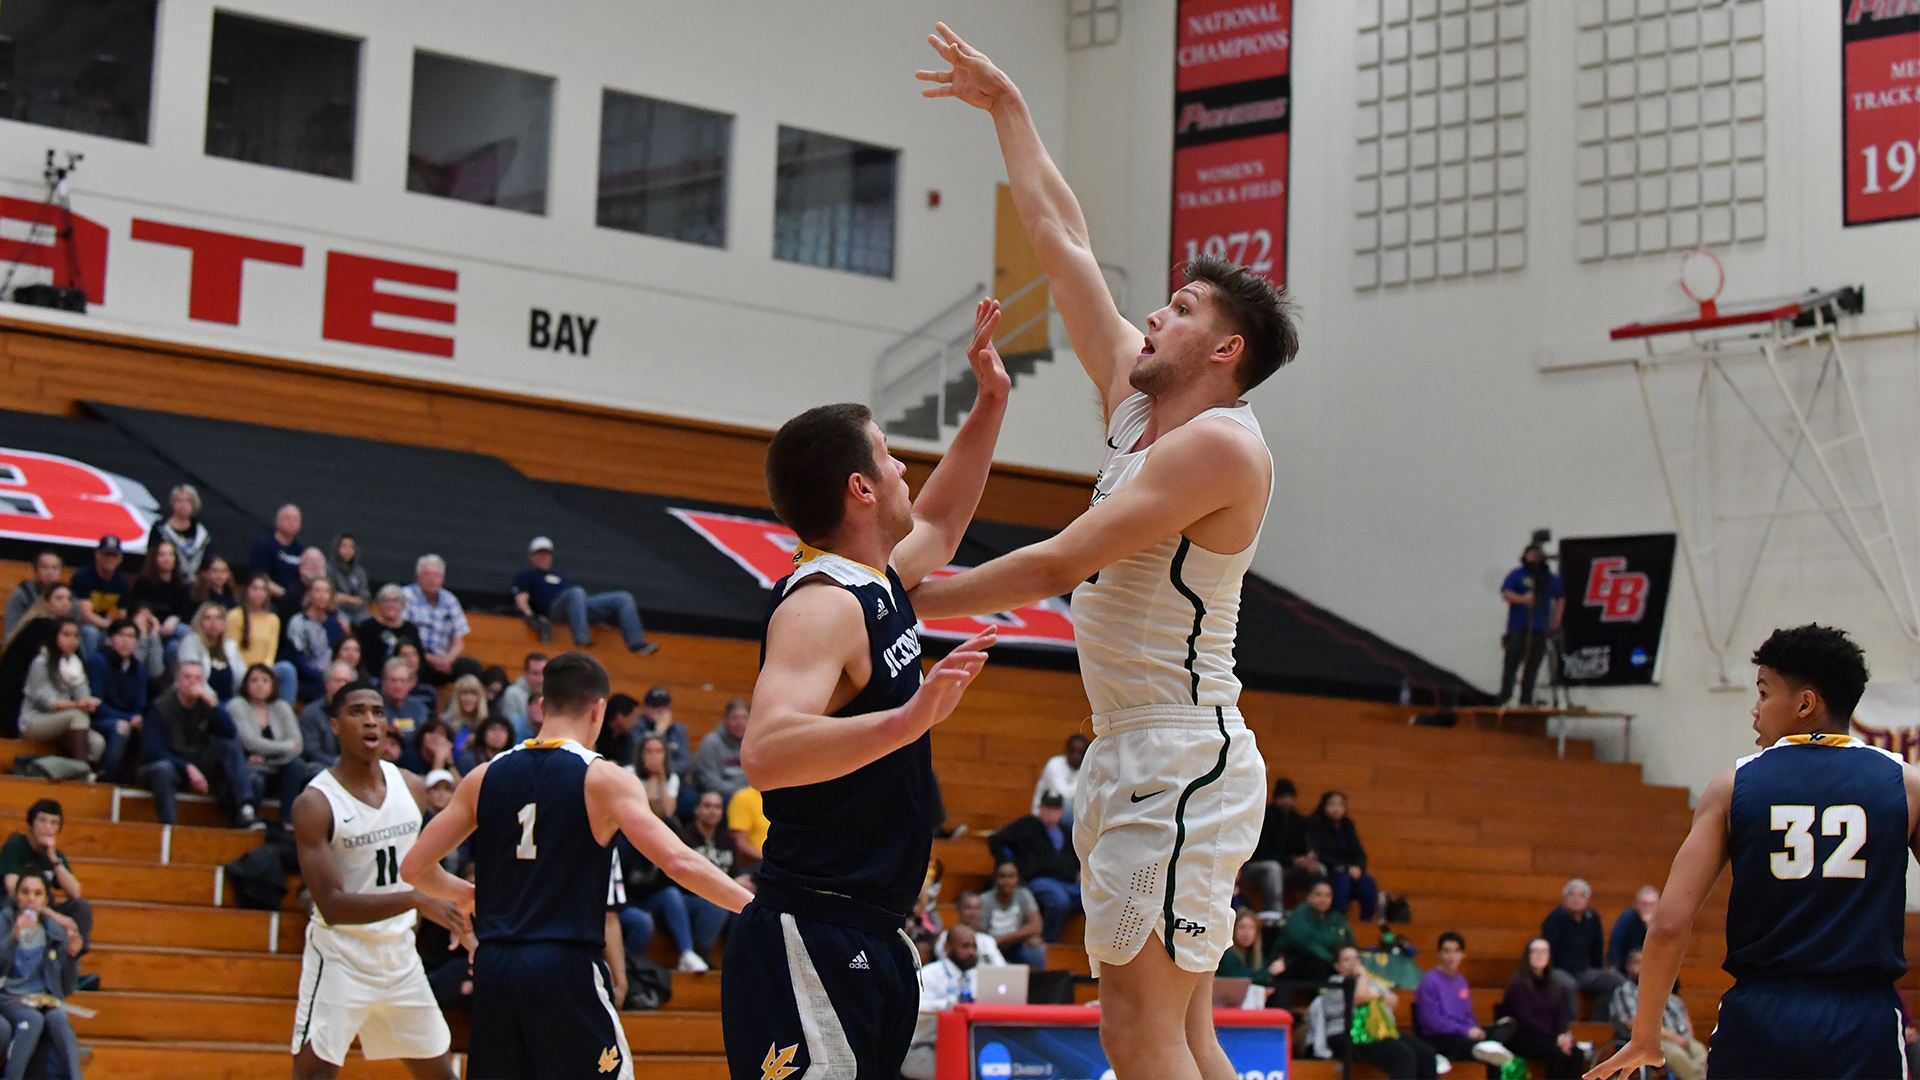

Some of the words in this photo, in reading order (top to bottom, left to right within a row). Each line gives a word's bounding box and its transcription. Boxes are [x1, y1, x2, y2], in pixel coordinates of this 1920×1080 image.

[1188, 2, 1281, 36] NATIONAL
[1179, 29, 1289, 67] CHAMPIONS
[1852, 87, 1912, 111] TRACK
[1861, 139, 1920, 195] 19
[529, 307, 598, 356] BAY
[1583, 556, 1649, 622] EB
[516, 802, 537, 860] 1
[1770, 804, 1867, 880] 32
[376, 846, 398, 887] 11
